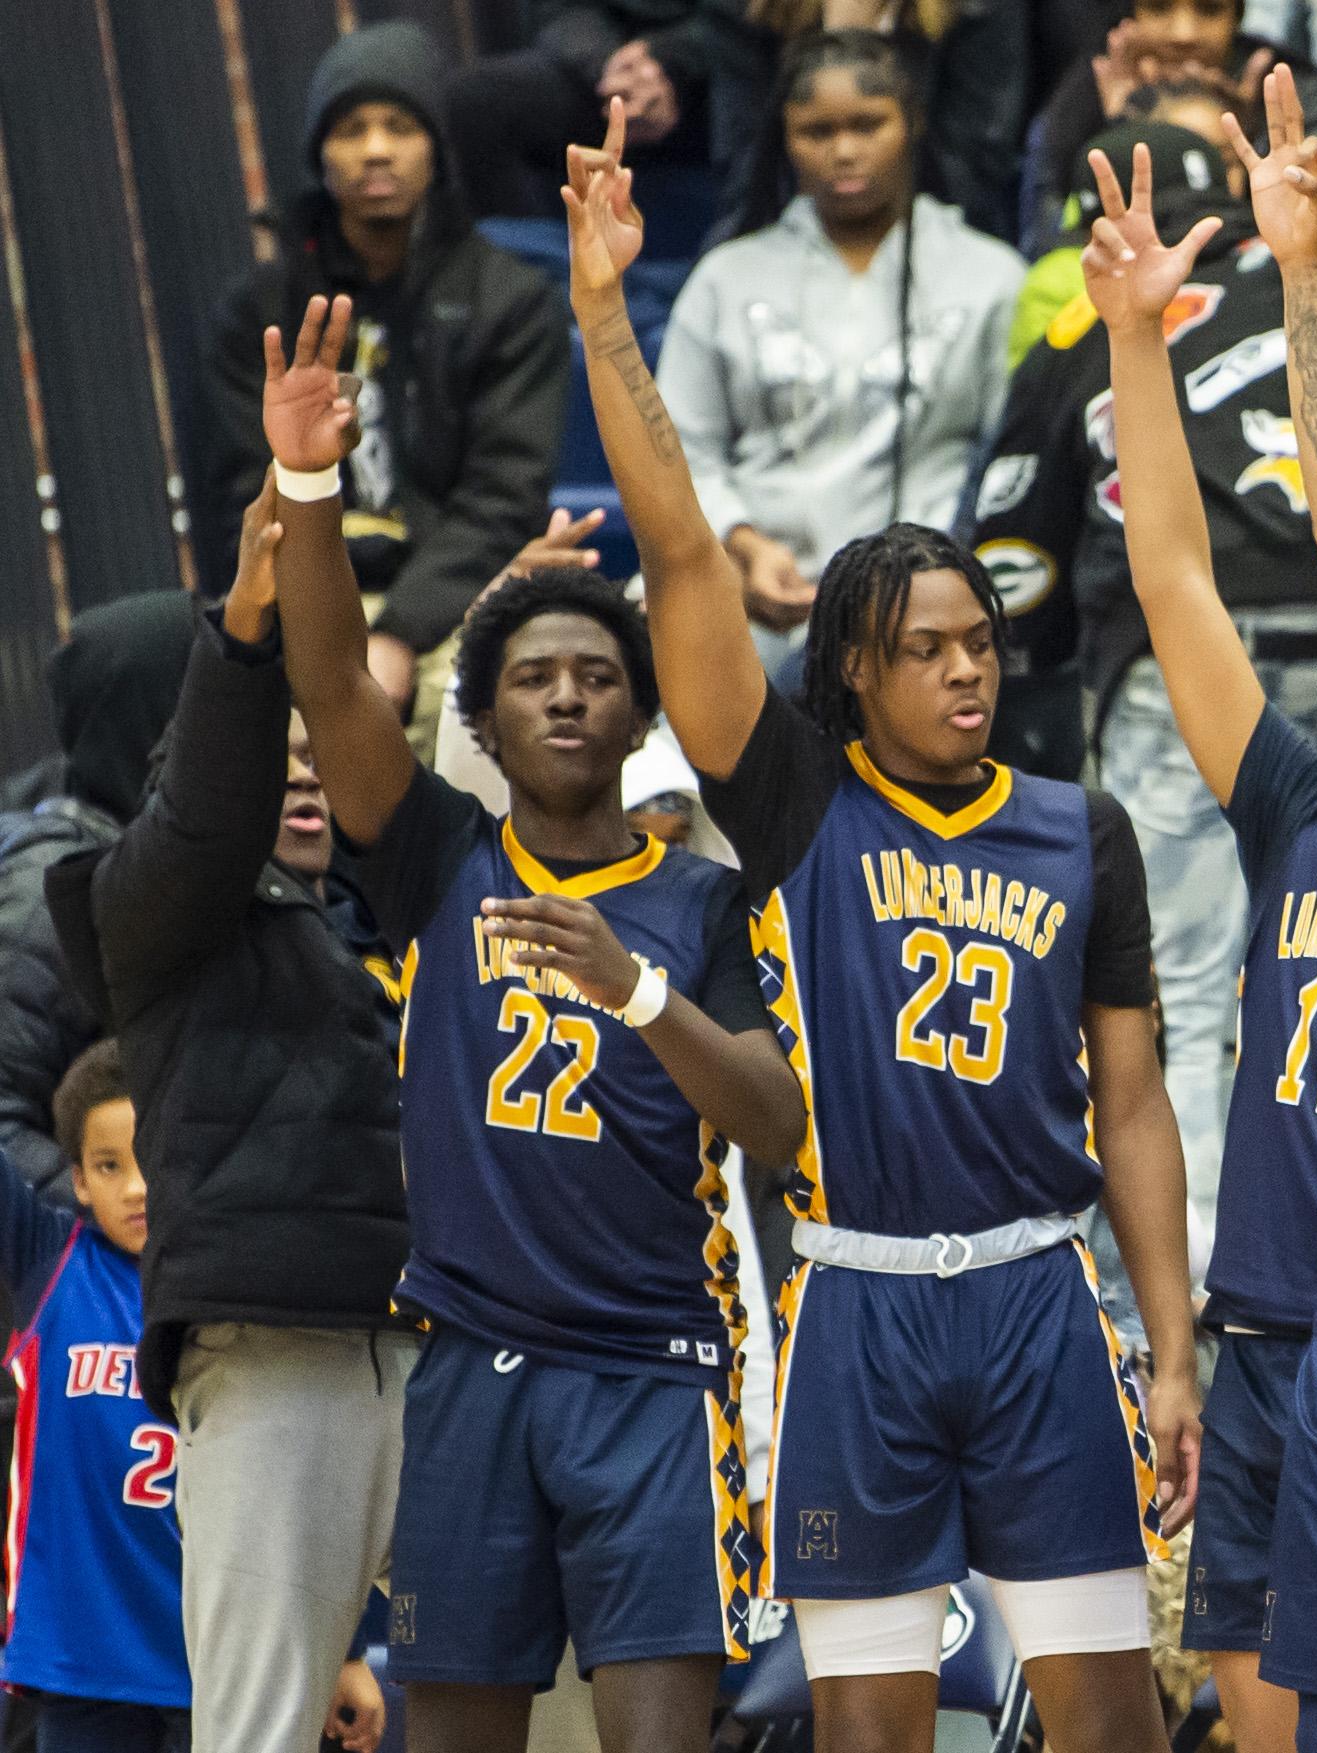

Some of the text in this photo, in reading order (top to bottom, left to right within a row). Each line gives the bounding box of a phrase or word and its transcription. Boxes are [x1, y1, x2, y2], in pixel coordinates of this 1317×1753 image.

[486, 986, 602, 1143] 22
[895, 926, 1014, 1086] 23
[122, 1422, 177, 1509] 2
